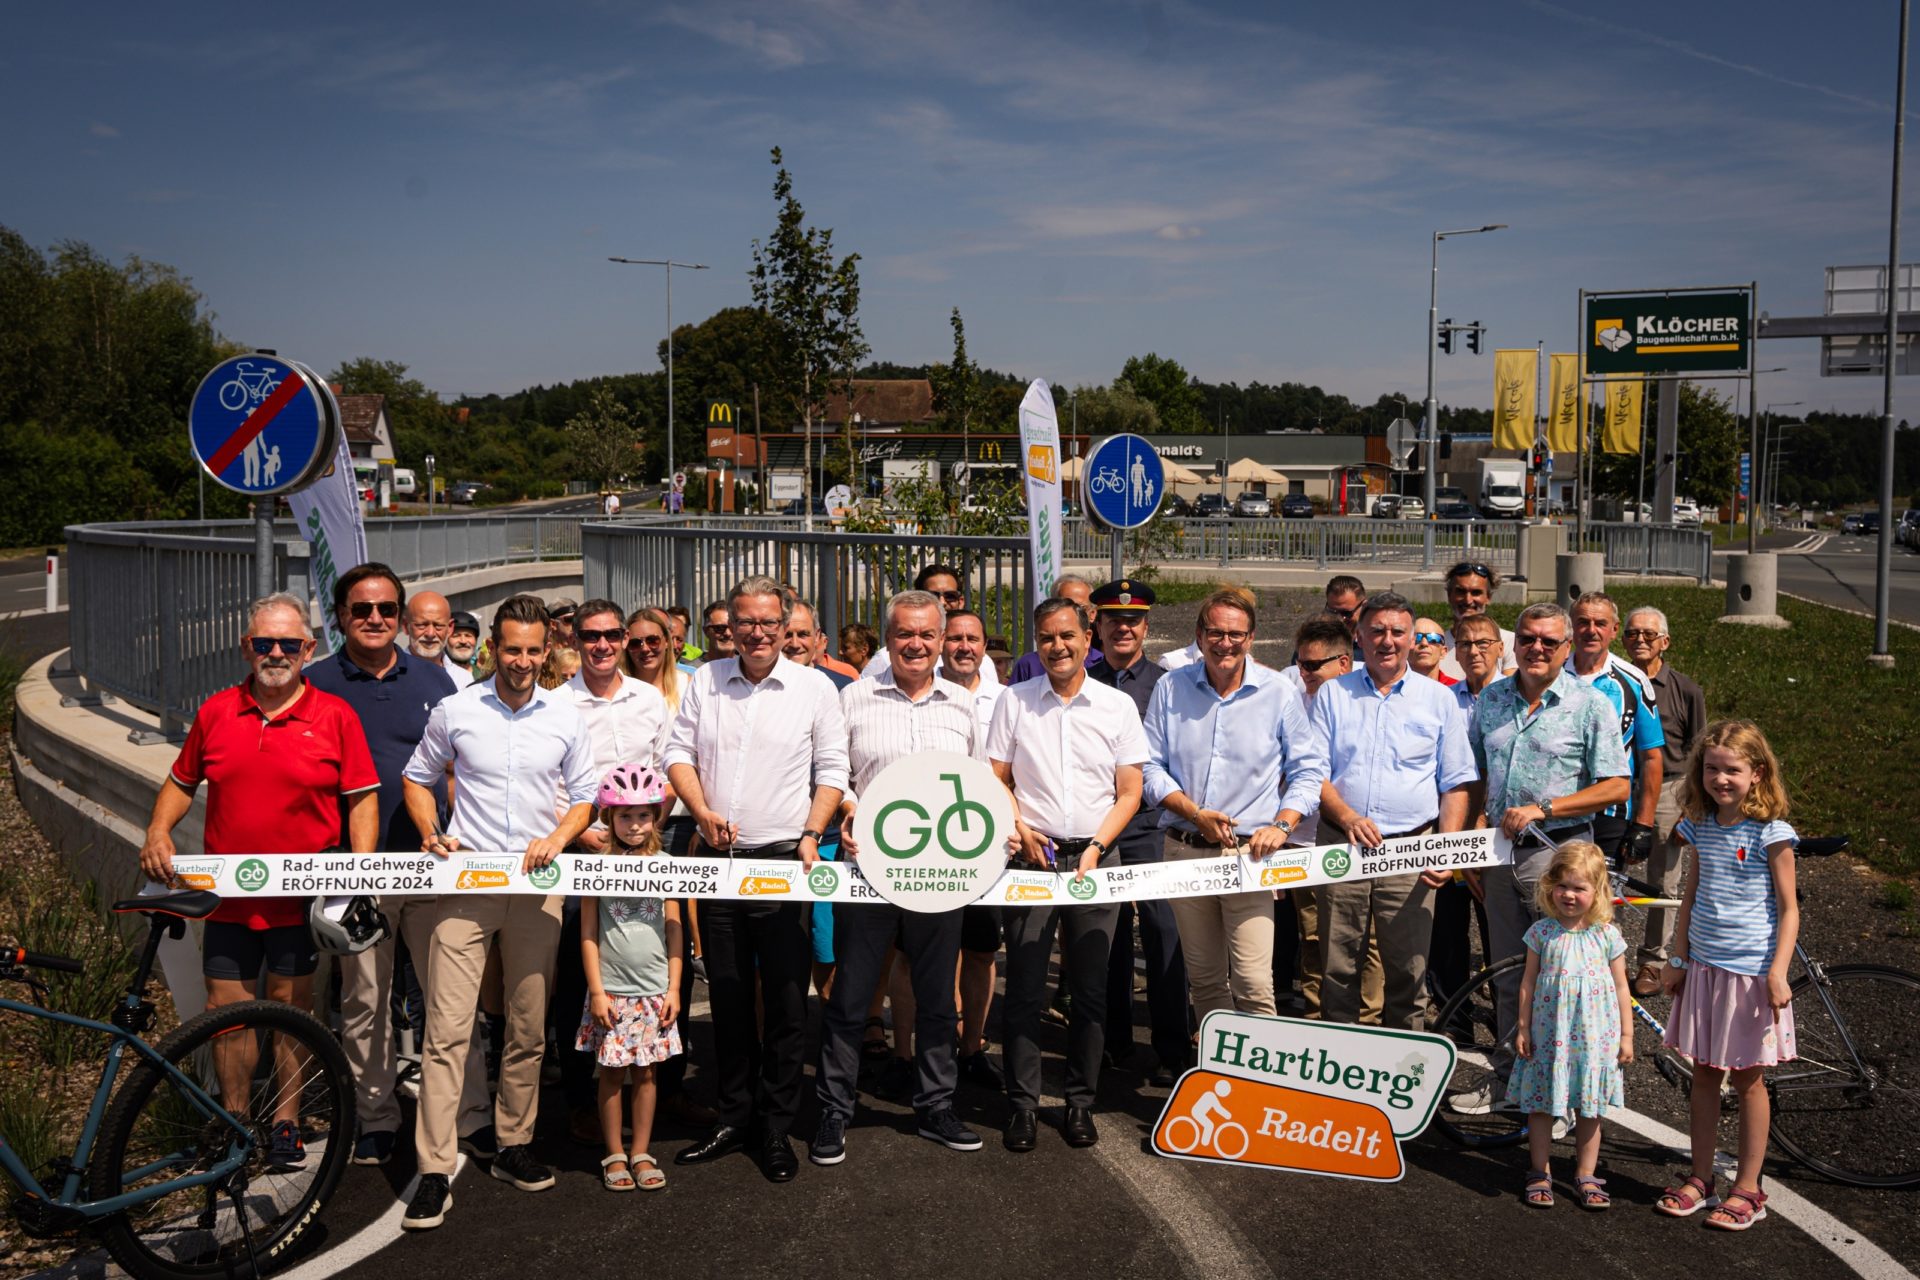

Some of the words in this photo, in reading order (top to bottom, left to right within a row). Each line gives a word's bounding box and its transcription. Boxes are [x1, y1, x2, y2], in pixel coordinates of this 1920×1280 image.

[1636, 314, 1740, 335] KLÖCHER
[1636, 334, 1708, 345] Baugesellschaft
[1153, 445, 1203, 456] onald's
[873, 780, 995, 860] GO
[1360, 841, 1392, 859] Rad-
[1395, 839, 1421, 854] und
[1425, 834, 1487, 853] Gehwege
[283, 858, 320, 872] Rad-
[325, 858, 355, 872] und
[359, 857, 435, 874] Gehwege
[465, 859, 513, 873] Hartberg
[574, 858, 610, 873] Rad-
[614, 859, 644, 873] und
[647, 861, 720, 879] Gehwege
[1361, 853, 1448, 875] ERÖFFNUNG
[1452, 850, 1488, 864] 2024
[748, 866, 794, 879] Hartberg
[886, 867, 978, 879] STEIERMARK
[1106, 868, 1140, 882] Rad-
[281, 874, 387, 891] ERÖFFNUNG
[392, 876, 434, 889] 2024
[572, 875, 674, 893] ERÖFFNUNG
[678, 879, 718, 894] 2024
[894, 881, 970, 892] RADMOBIL
[1203, 876, 1241, 891] 2024
[1209, 1029, 1421, 1110] Hartberg
[1256, 1107, 1382, 1159] Radelt
[270, 1199, 321, 1257] MAXXIS
